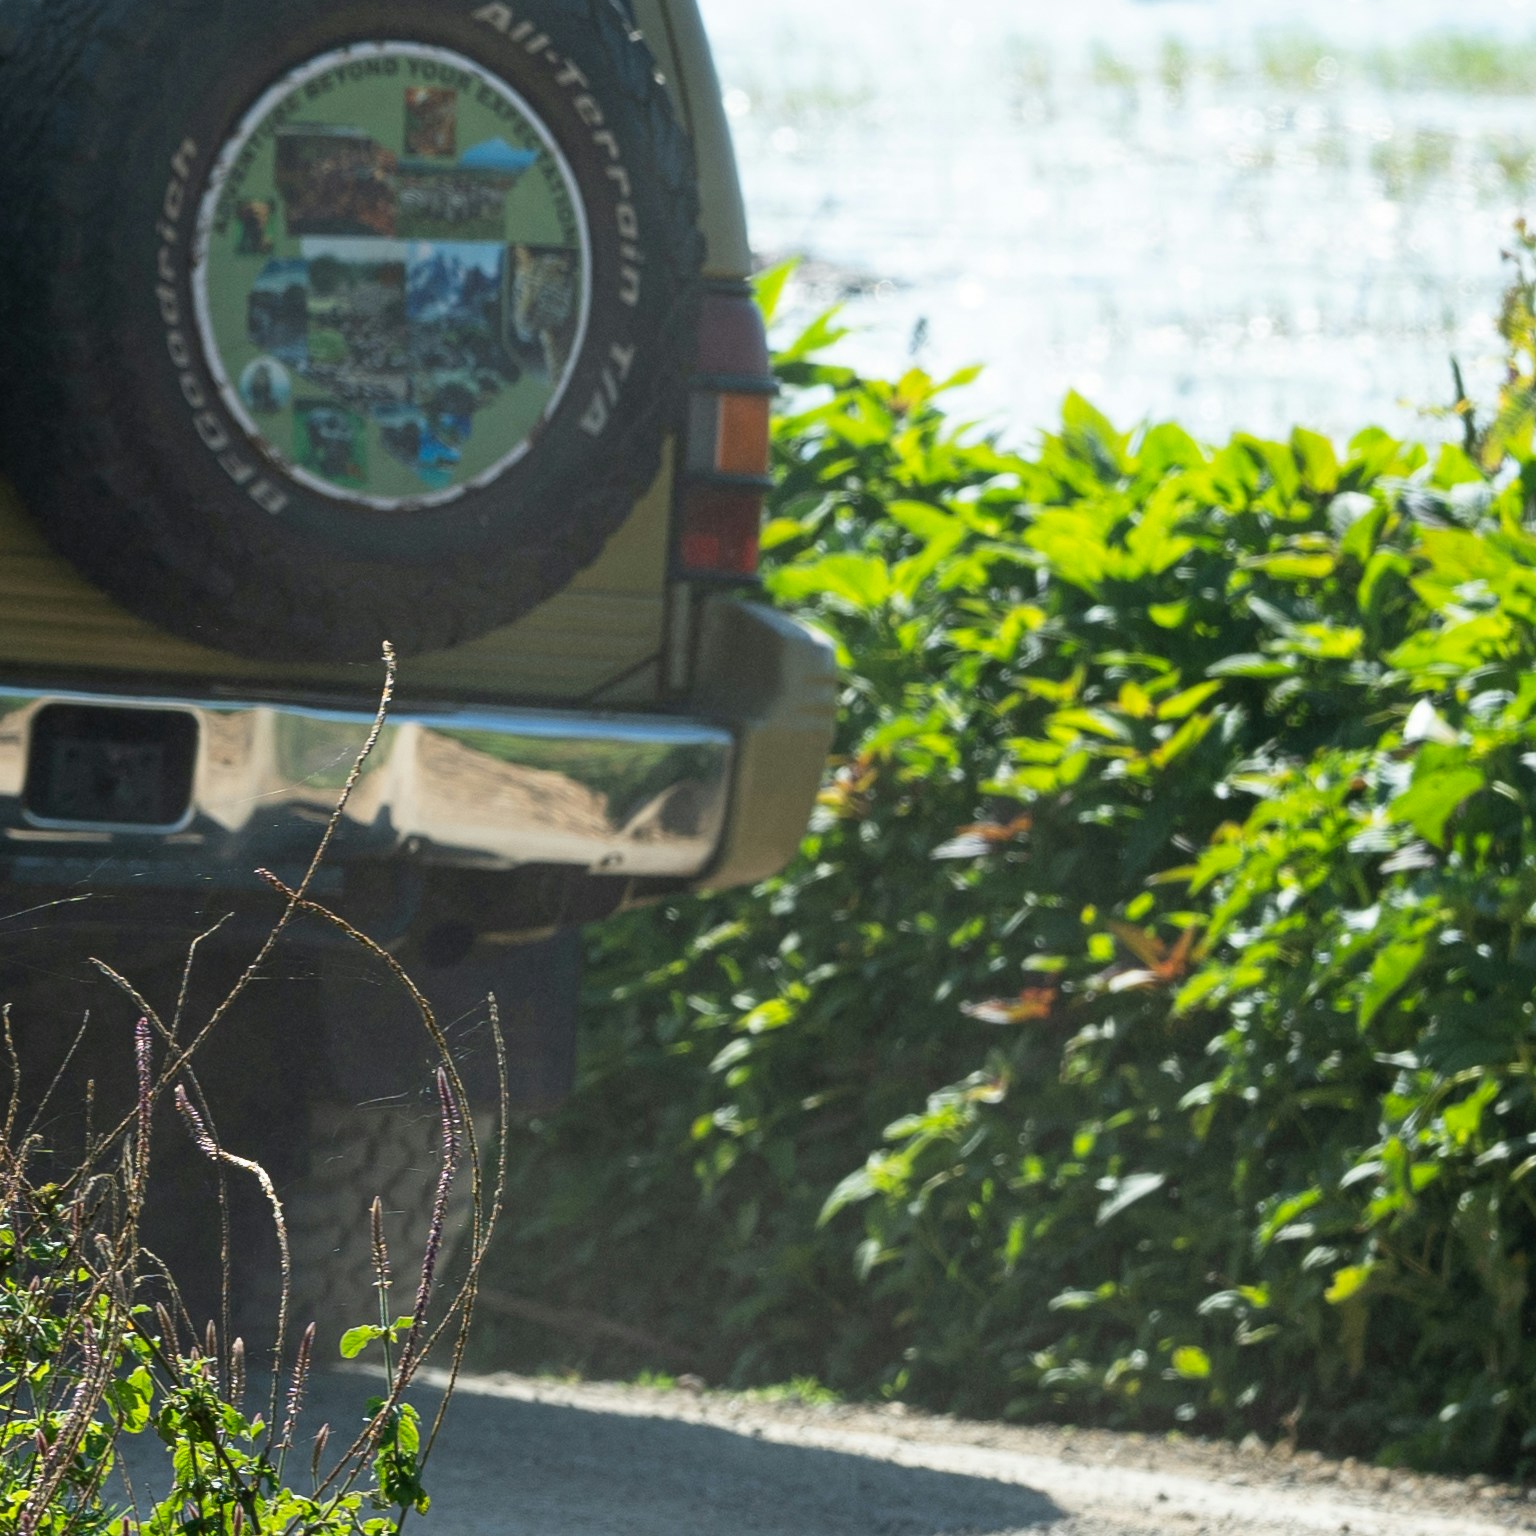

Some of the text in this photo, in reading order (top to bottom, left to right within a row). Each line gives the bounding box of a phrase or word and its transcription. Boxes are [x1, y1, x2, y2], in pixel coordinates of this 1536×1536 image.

[304, 58, 399, 100] BEYOND
[407, 59, 474, 94] YOUR
[578, 341, 637, 437] T/A
